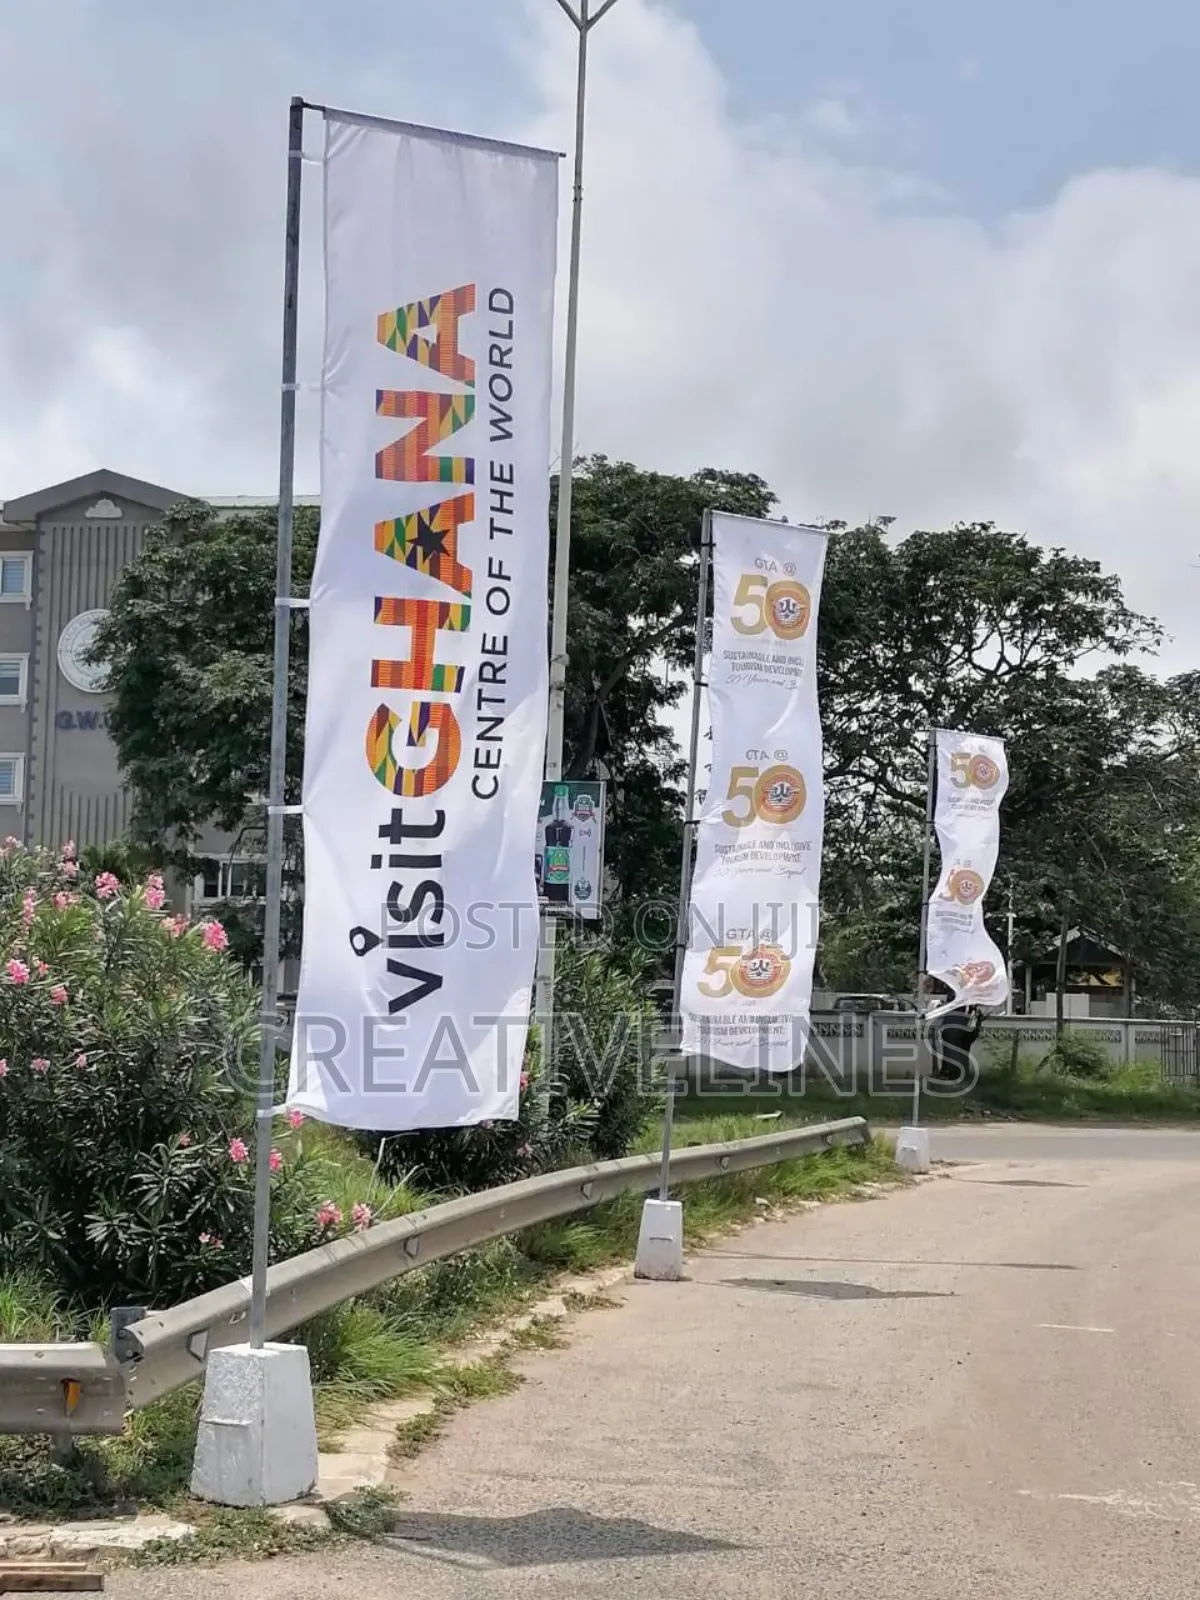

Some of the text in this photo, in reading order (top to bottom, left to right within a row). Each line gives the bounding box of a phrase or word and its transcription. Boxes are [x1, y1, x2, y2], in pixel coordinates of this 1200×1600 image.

[471, 287, 514, 800] CENTRE OF THE WORLD
[754, 557, 778, 573] GTA
[730, 573, 811, 641] 50
[731, 661, 763, 673] TOURISM
[721, 764, 807, 828] 50
[950, 751, 1001, 791] 50
[696, 943, 792, 999] 50
